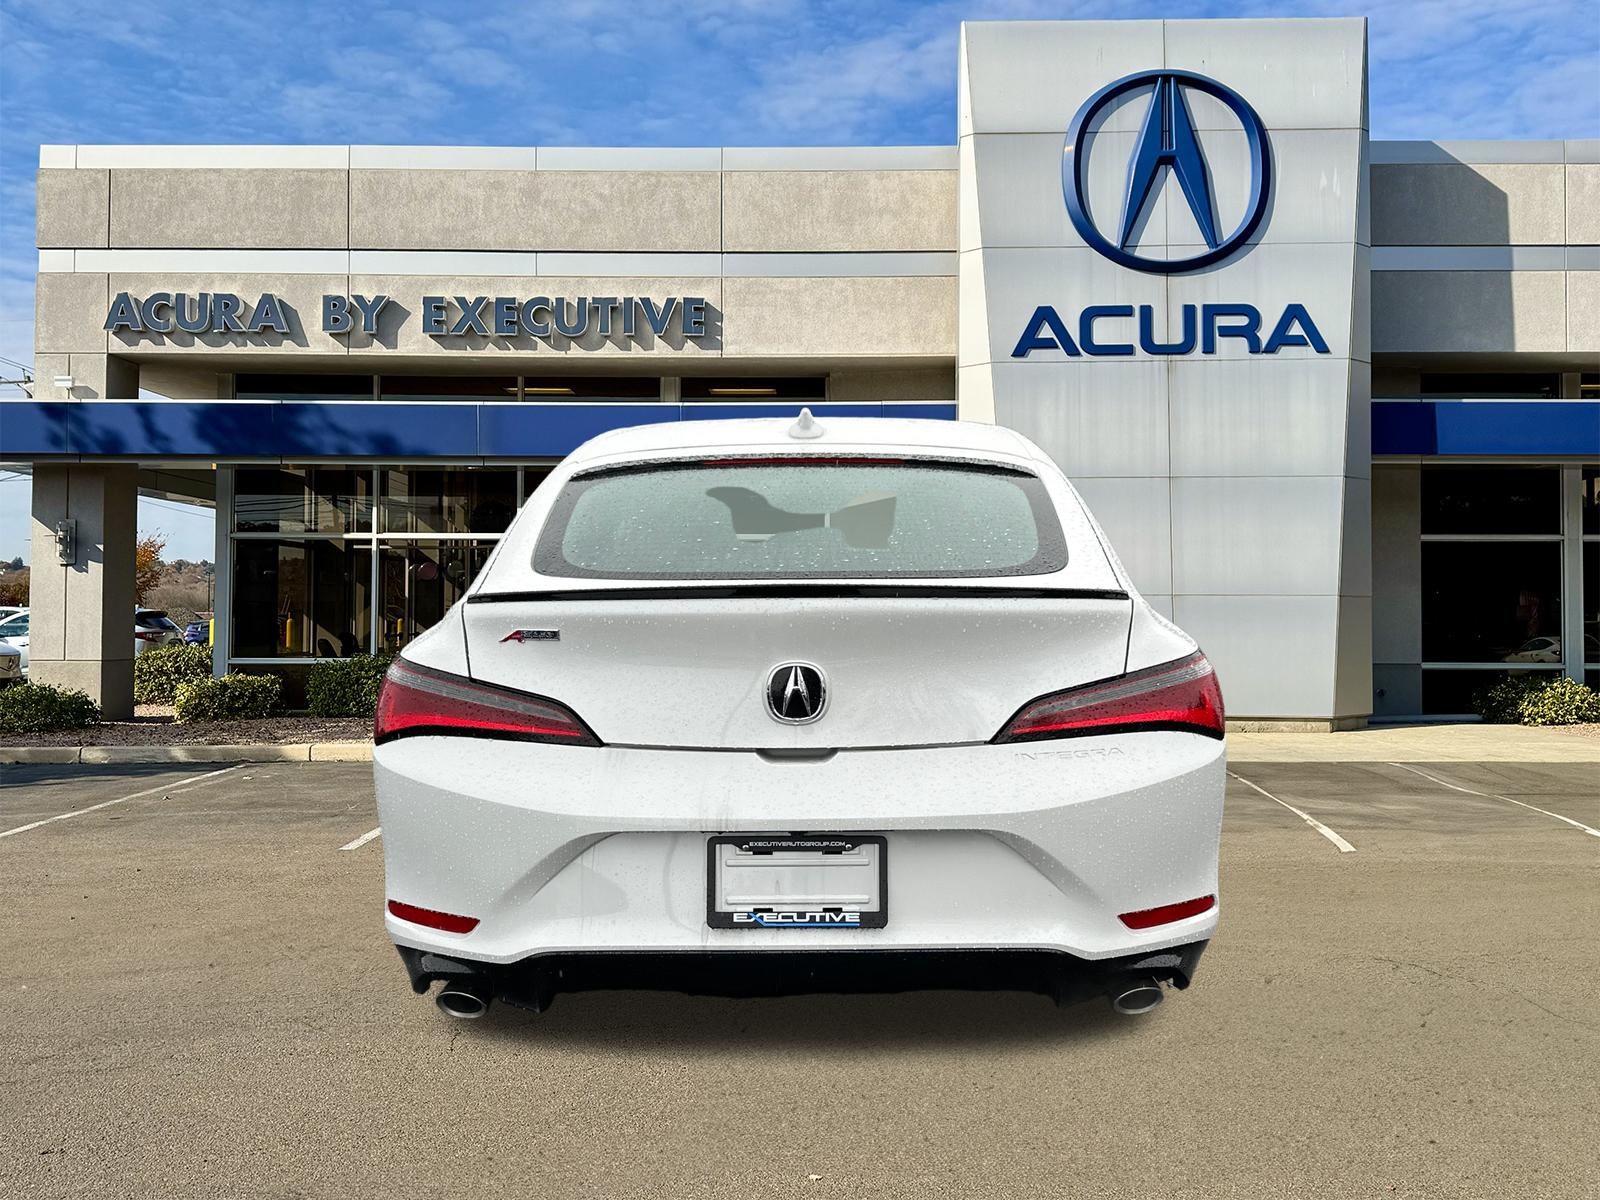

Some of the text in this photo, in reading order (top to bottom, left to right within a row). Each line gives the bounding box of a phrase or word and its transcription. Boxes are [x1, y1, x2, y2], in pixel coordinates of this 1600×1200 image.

[104, 292, 707, 337] ACURA BY EXECUTIVE
[1011, 303, 1332, 357] ACURA
[733, 912, 860, 924] EXECUTIVE
